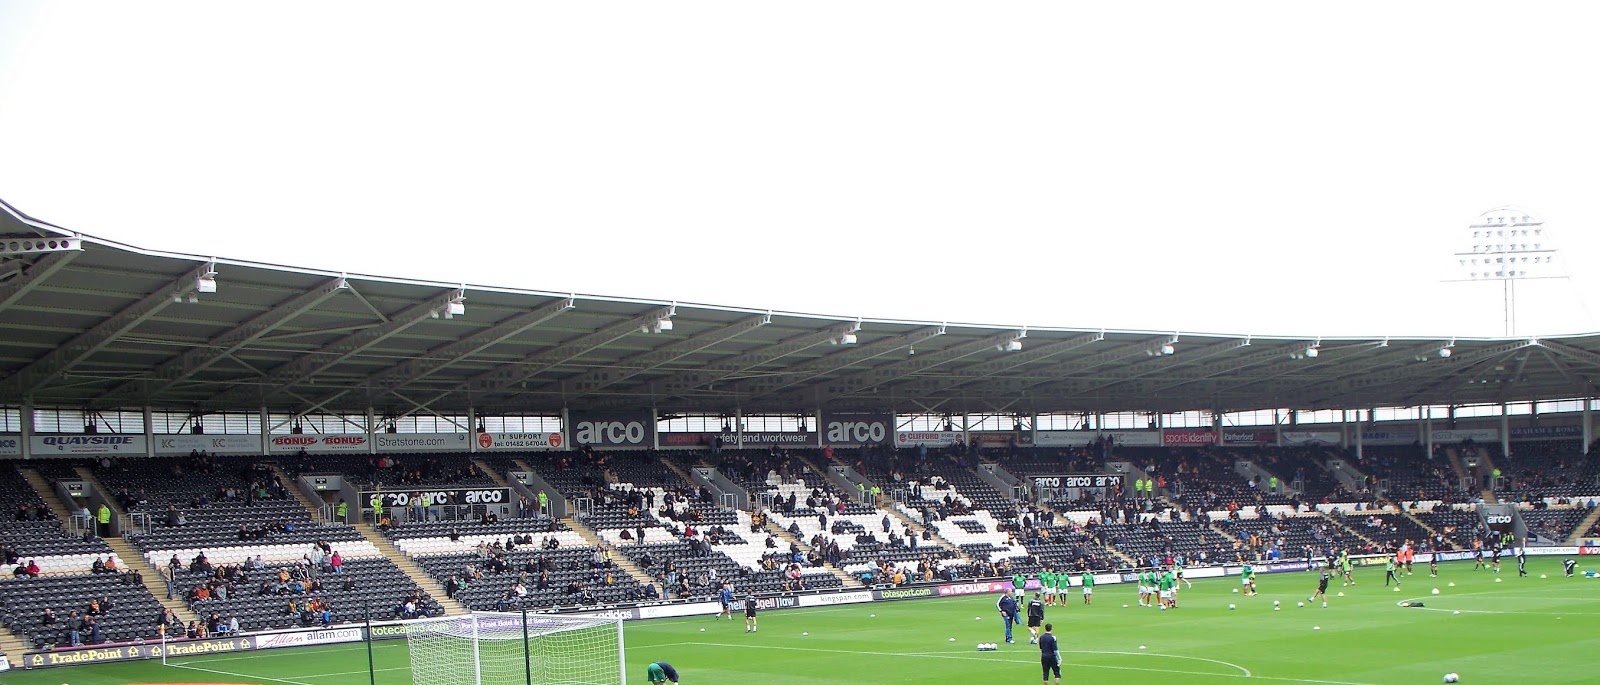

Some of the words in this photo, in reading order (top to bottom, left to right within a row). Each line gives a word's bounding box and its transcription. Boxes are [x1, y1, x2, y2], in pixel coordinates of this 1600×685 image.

[576, 421, 645, 444] arco
[827, 421, 886, 442] arco
[907, 432, 939, 440] CLIFFORD
[42, 436, 134, 446] QUAYSIDE
[275, 437, 316, 446] BONUS
[325, 436, 364, 446] BONUS
[378, 437, 446, 447] Stratstone.com
[742, 433, 759, 443] and
[762, 433, 808, 443] workwear
[1035, 477, 1060, 487] arco
[1066, 476, 1091, 487] arco
[465, 489, 501, 504] arco
[1487, 515, 1512, 524] arco
[881, 588, 931, 598] totesport.com
[950, 582, 992, 594] npower
[820, 592, 870, 602] kingspan.com
[371, 622, 449, 636] totecasino.com
[306, 629, 359, 641] allam.com
[166, 640, 236, 655] TradePoint
[48, 648, 123, 664] TradePoint
